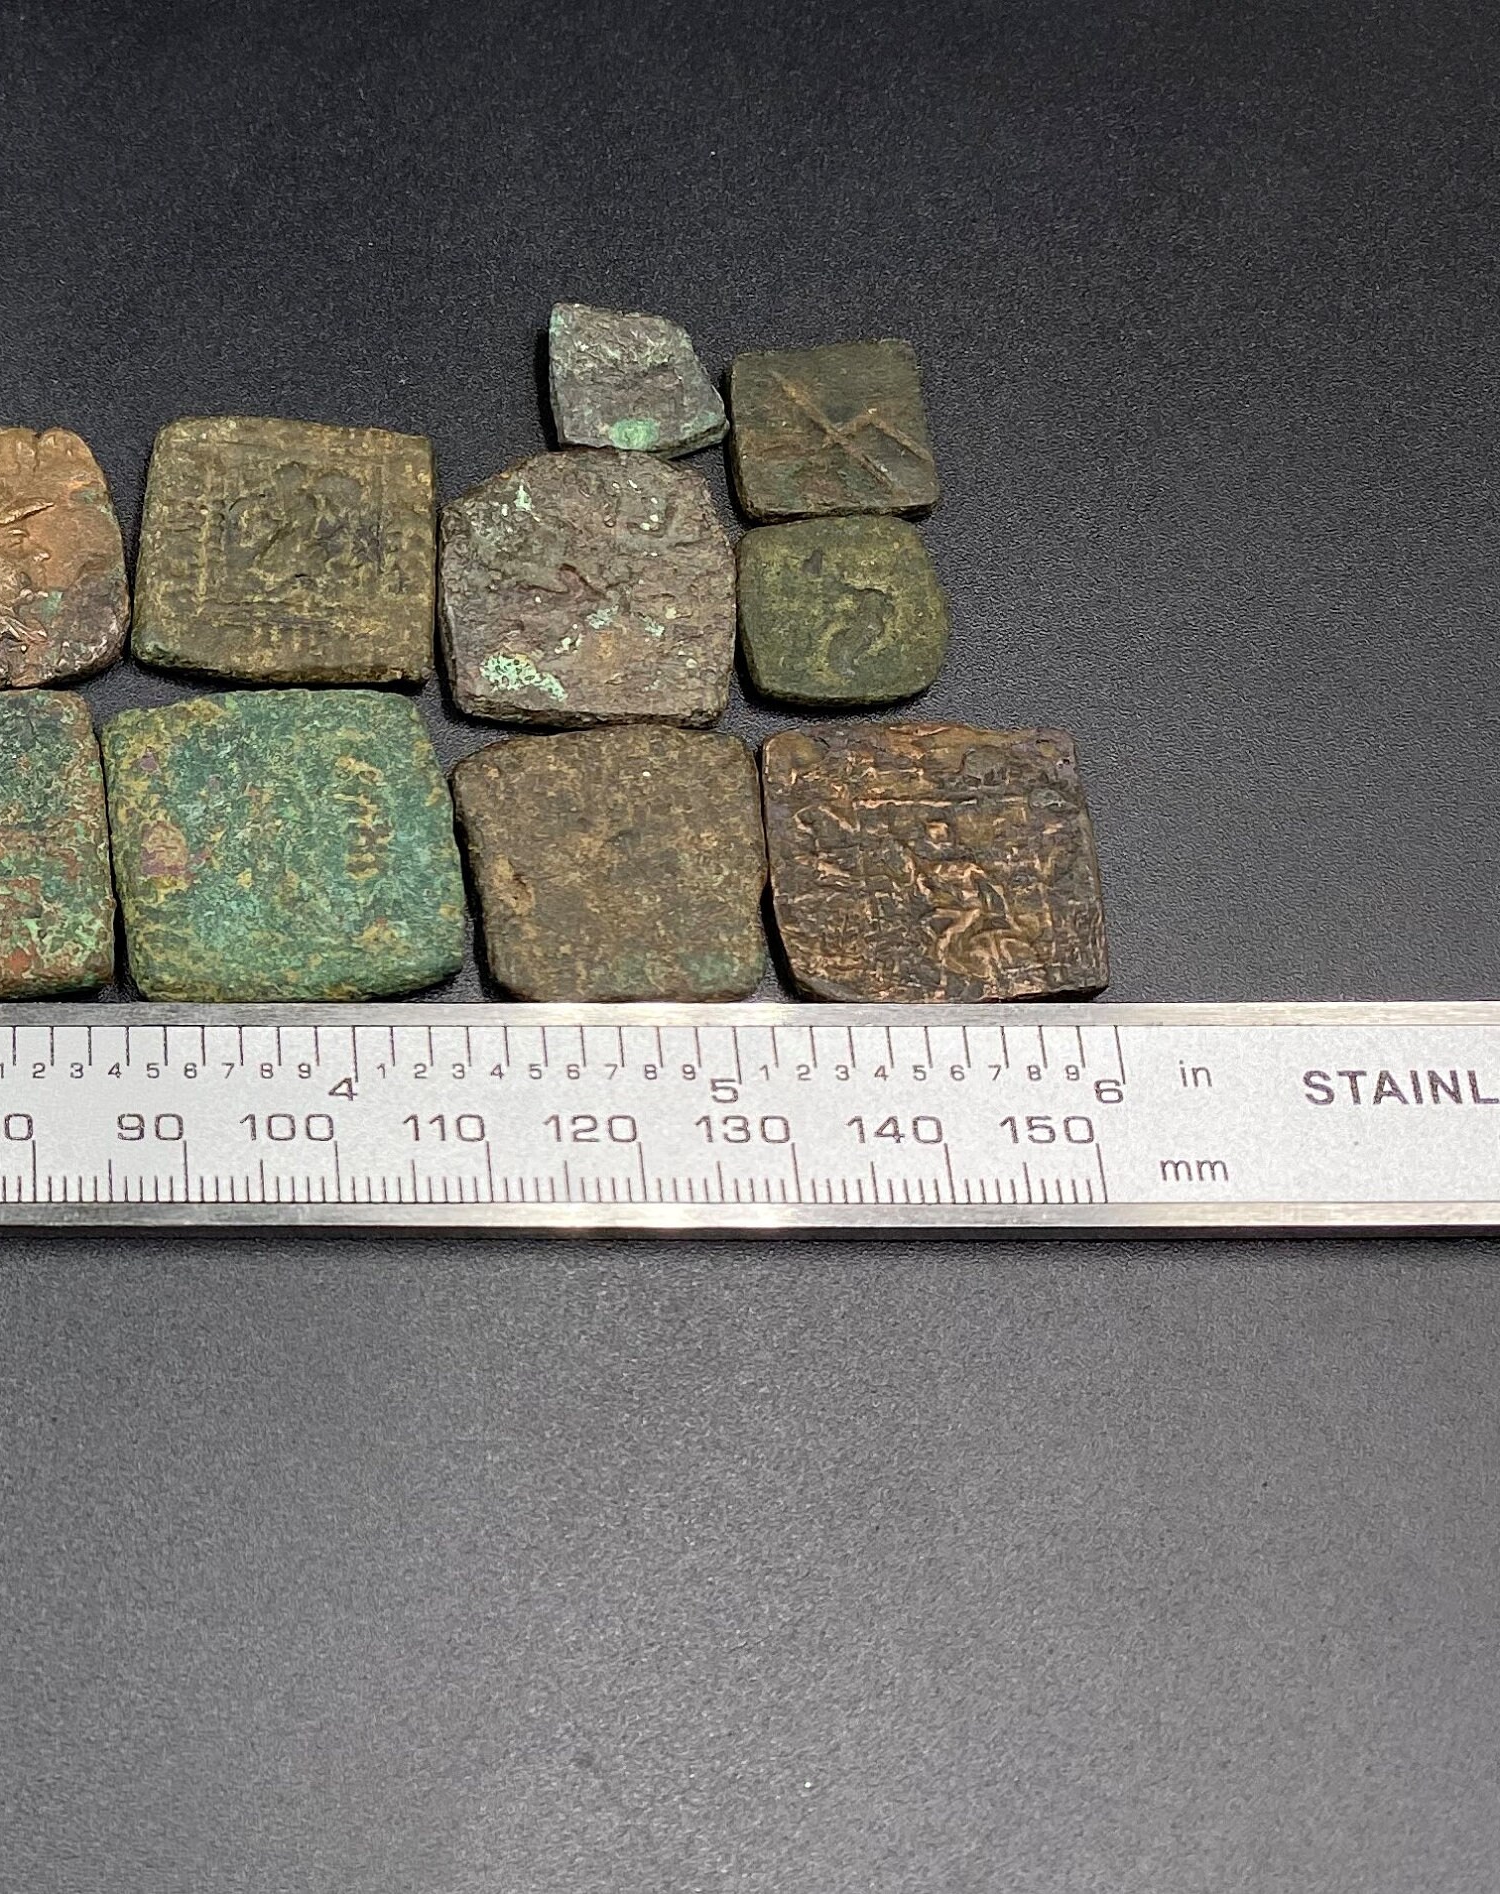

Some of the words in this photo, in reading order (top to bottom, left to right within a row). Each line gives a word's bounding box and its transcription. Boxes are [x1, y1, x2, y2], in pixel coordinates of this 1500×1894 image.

[31, 1061, 47, 1080] 2
[69, 1061, 85, 1080] 3
[107, 1061, 123, 1080] 4
[145, 1061, 161, 1080] 5
[183, 1061, 198, 1080] 6
[220, 1061, 236, 1080] 7
[259, 1061, 275, 1080] 8
[296, 1061, 313, 1080] 9
[327, 1076, 360, 1102] 4
[375, 1062, 387, 1080] 1
[412, 1061, 429, 1080] 2
[451, 1061, 466, 1081] 3
[488, 1062, 506, 1081] 4
[527, 1062, 543, 1081] 5
[565, 1063, 581, 1081] 6
[603, 1062, 619, 1081] 7
[642, 1063, 658, 1081] 8
[680, 1063, 697, 1082] 9
[709, 1077, 740, 1105] 5
[758, 1063, 771, 1082] 1
[795, 1063, 812, 1082] 2
[833, 1064, 851, 1082] 3
[873, 1064, 890, 1082] 4
[911, 1063, 928, 1082] 5
[949, 1063, 966, 1082] 6
[987, 1063, 1003, 1082] 7
[1025, 1063, 1043, 1082] 8
[1063, 1063, 1081, 1082] 9
[1093, 1078, 1124, 1105] 6
[1178, 1059, 1213, 1088] in
[1302, 1069, 1500, 1107] STAINL
[116, 1112, 185, 1142] 90
[238, 1112, 335, 1142] 100
[401, 1113, 487, 1143] 110
[541, 1113, 639, 1144] 120
[693, 1114, 792, 1145] 130
[845, 1115, 944, 1146] 140
[998, 1114, 1096, 1145] 150
[1159, 1159, 1230, 1183] mm
